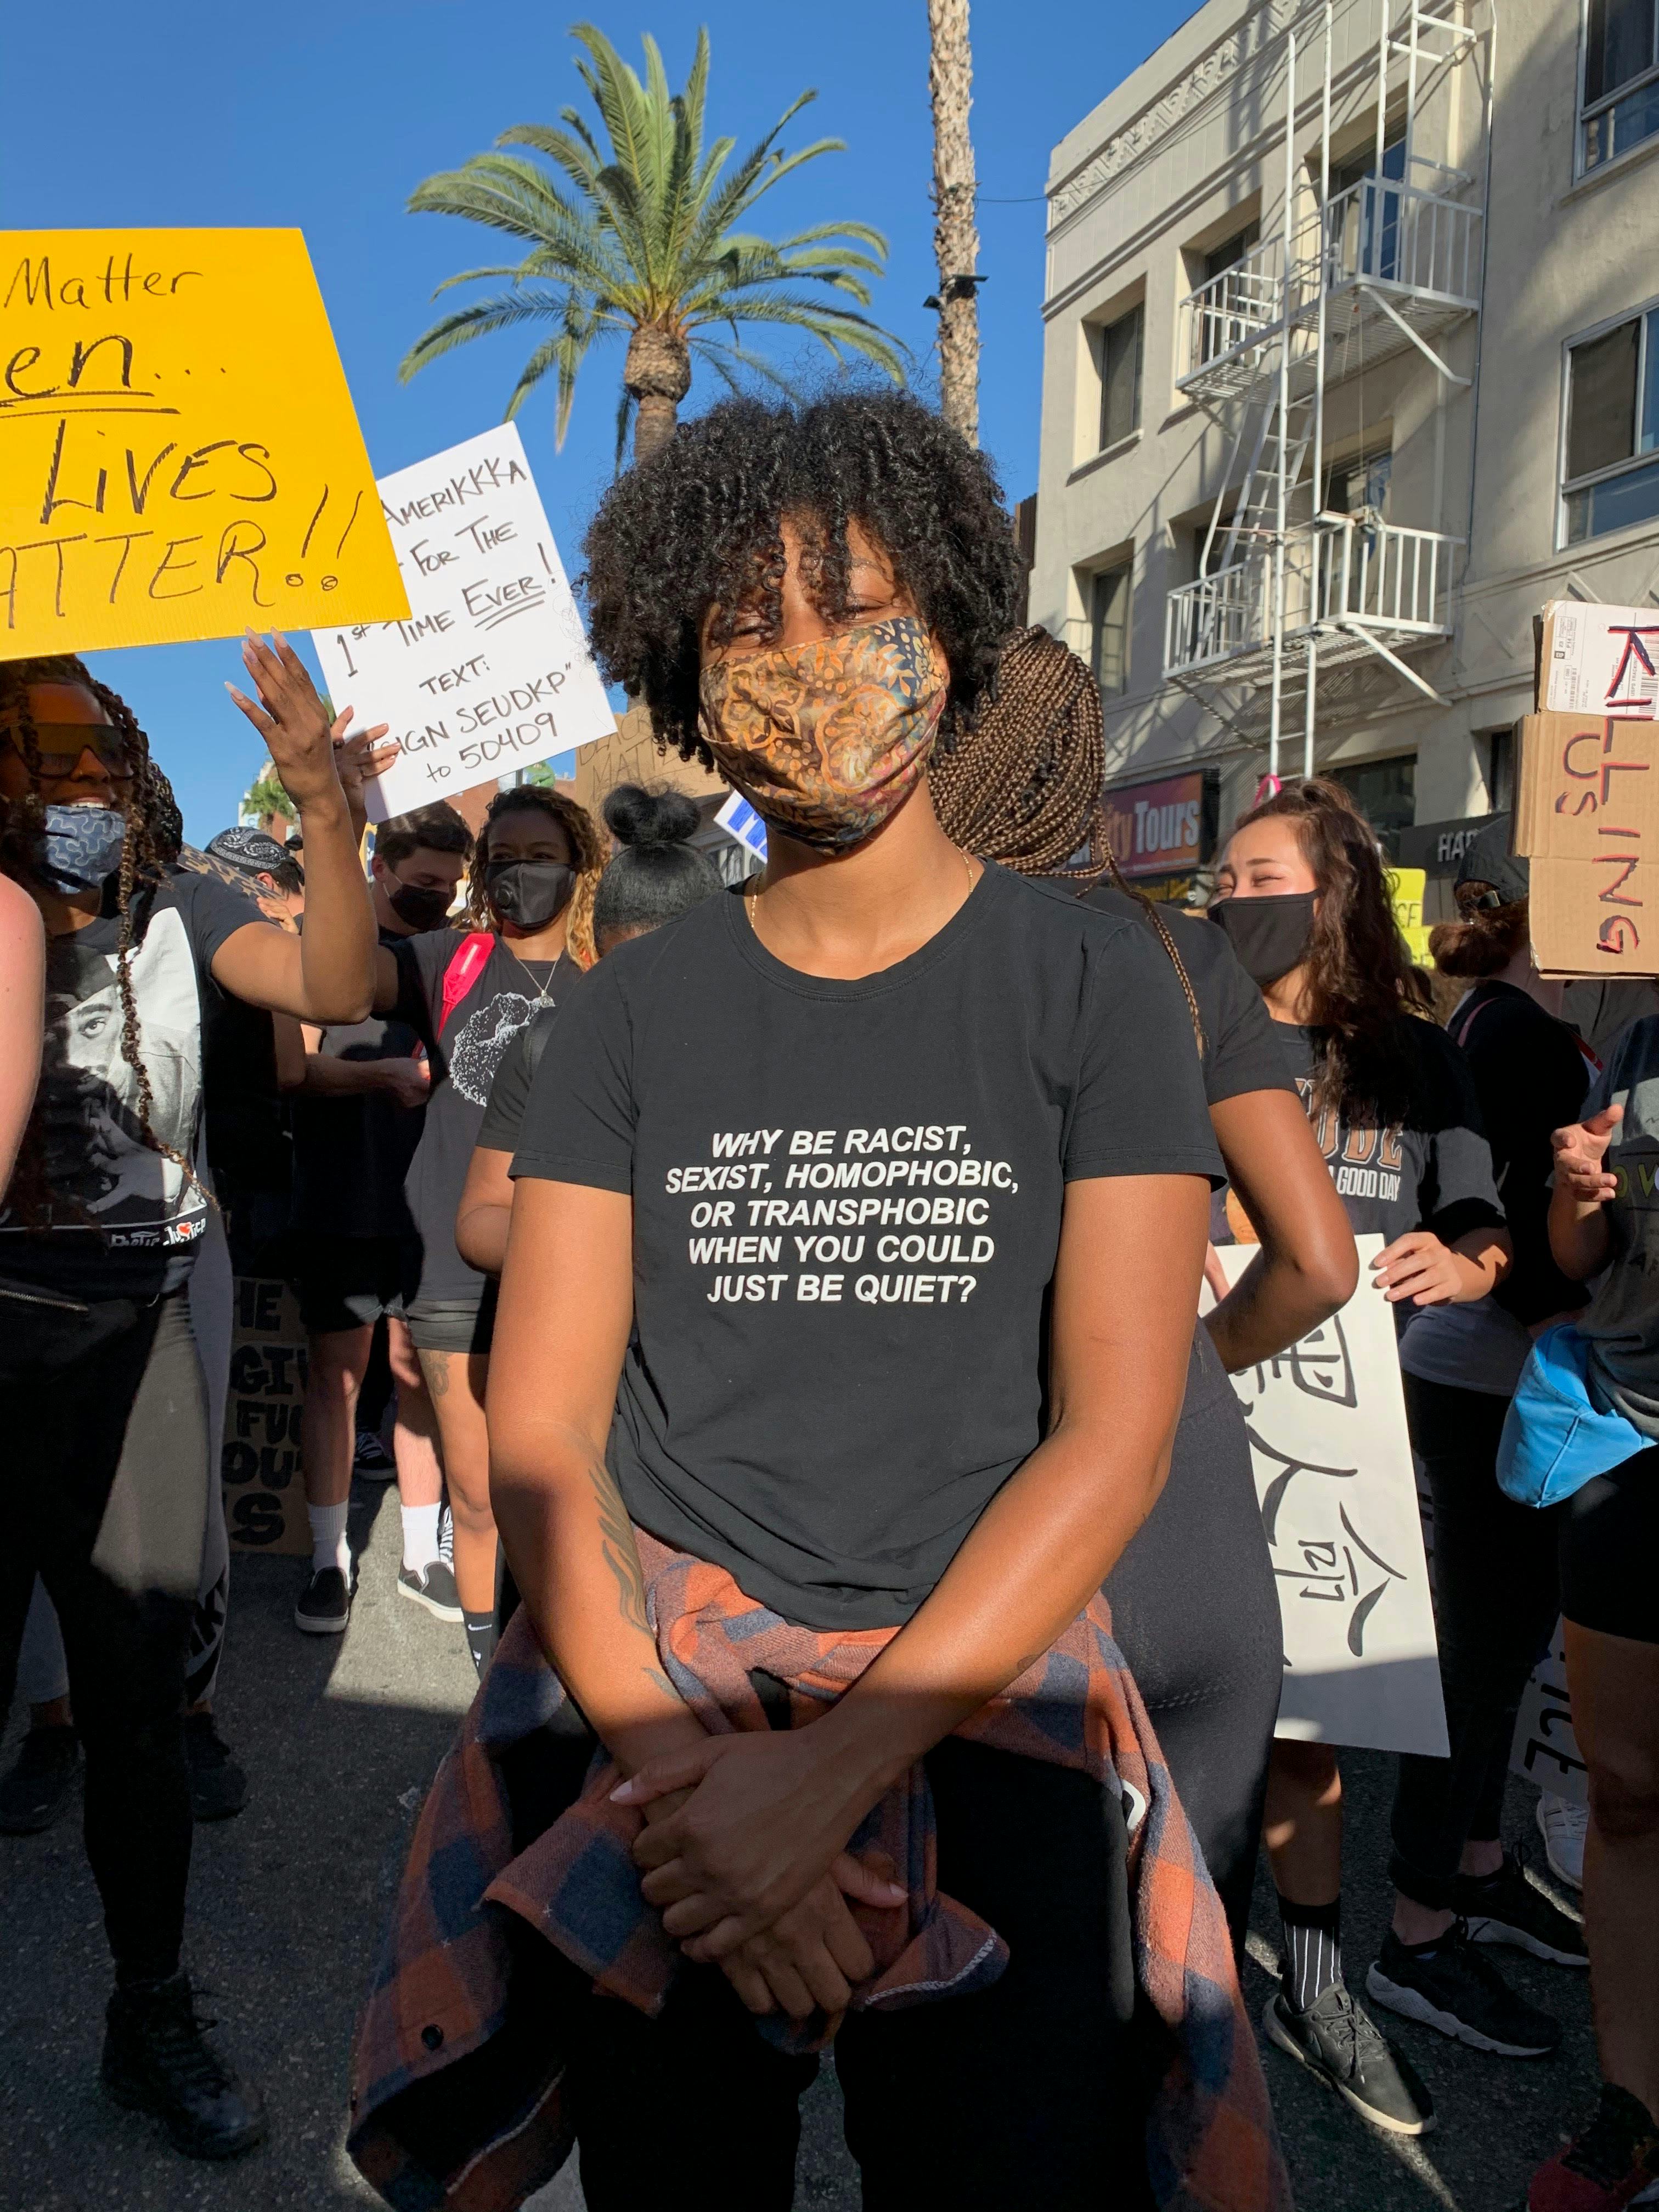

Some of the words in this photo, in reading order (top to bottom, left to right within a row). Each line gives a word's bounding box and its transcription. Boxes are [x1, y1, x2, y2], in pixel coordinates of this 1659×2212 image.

[4, 252, 204, 310] Matter
[420, 654, 490, 696] TEXT:
[427, 763, 452, 783] to
[459, 712, 558, 770] 50409
[1134, 799, 1201, 854] Tours
[712, 1129, 783, 1158] WHY
[789, 1130, 836, 1155] BE
[844, 1126, 972, 1155] RACIST,
[665, 1164, 774, 1193] SEXIST,
[785, 1160, 1018, 1194] HOMOPHOBIC,
[1336, 1166, 1378, 1198] GOOD
[1379, 1172, 1401, 1202] DAY
[691, 1201, 736, 1228] OR
[748, 1198, 990, 1227] TRANSPHOBIC
[689, 1236, 782, 1264] WHEN
[794, 1235, 865, 1262] YOU
[877, 1235, 995, 1262] COULD
[707, 1275, 788, 1302] JUST
[797, 1275, 844, 1301] BE
[855, 1274, 977, 1304] QUIET?
